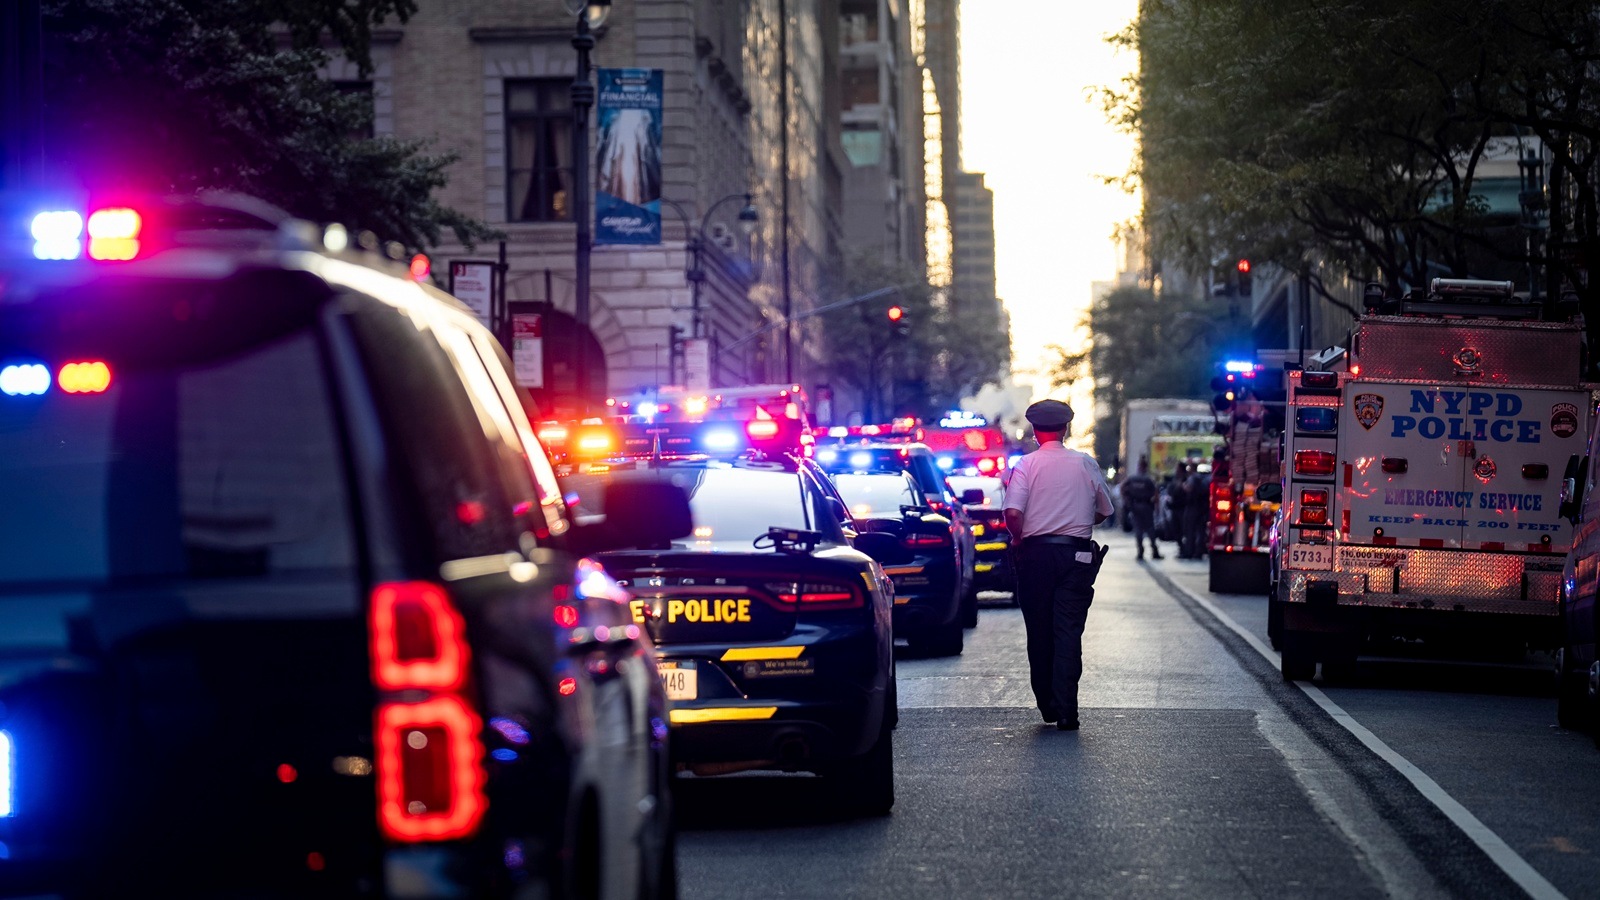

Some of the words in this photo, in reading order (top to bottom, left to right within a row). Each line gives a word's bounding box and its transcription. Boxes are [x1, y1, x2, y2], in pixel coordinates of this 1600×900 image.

[600, 91, 658, 102] FINANCIAL
[1410, 390, 1522, 417] NYPD
[1552, 403, 1577, 414] POLICE
[1391, 416, 1541, 444] POLICE
[1384, 488, 1474, 509] EMERGENCY
[1480, 492, 1542, 512] SERVICE
[1368, 515, 1415, 524] KEEP
[1422, 518, 1470, 527] BACK
[1478, 520, 1510, 529] 200
[1517, 522, 1561, 532] FEET
[1292, 550, 1322, 562] 5733
[1340, 550, 1372, 558] $10,000
[668, 599, 751, 623] POLICE
